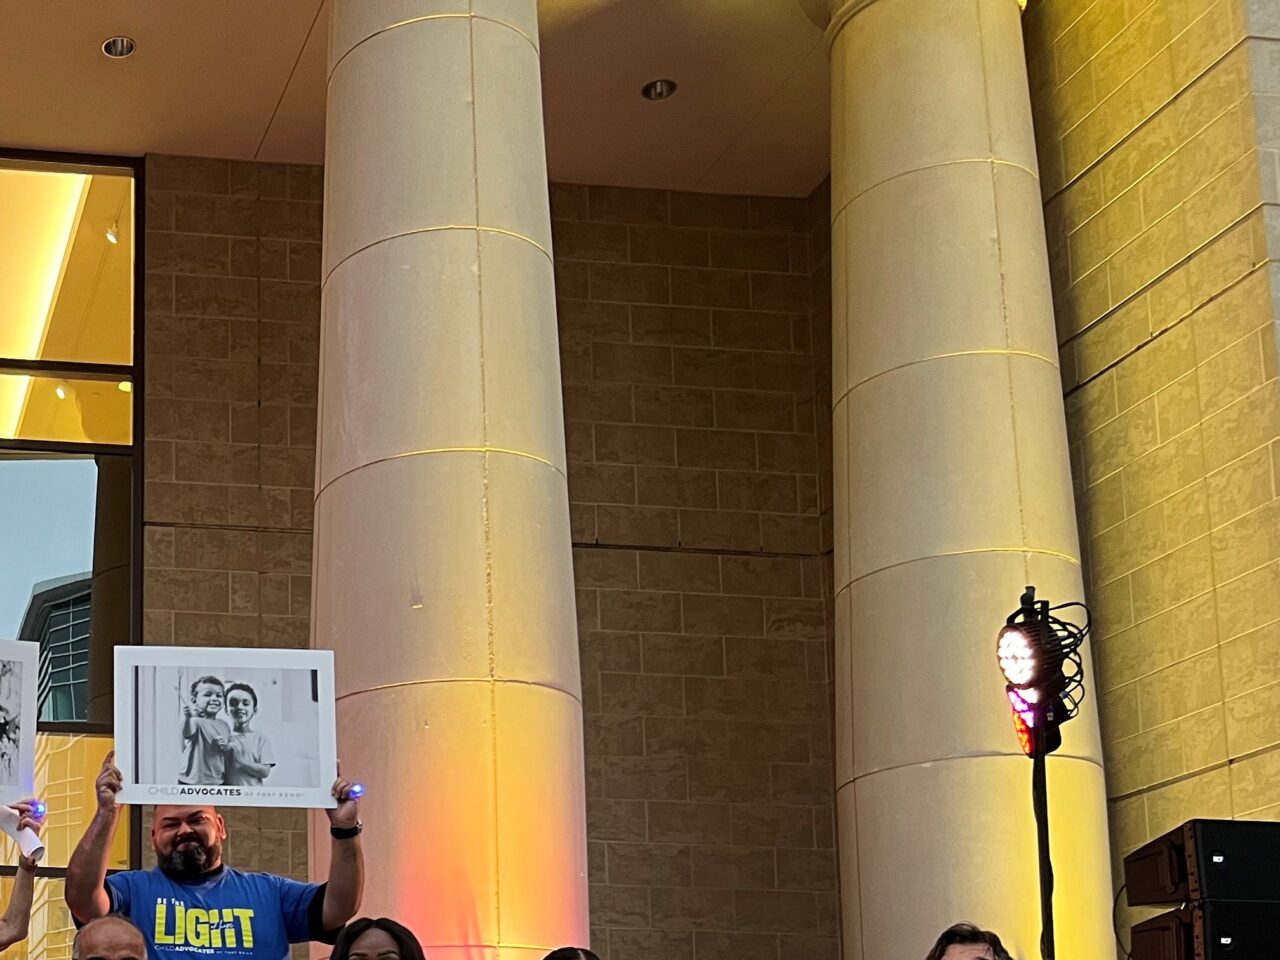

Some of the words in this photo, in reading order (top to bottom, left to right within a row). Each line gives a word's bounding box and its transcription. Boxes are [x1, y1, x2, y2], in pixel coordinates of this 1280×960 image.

[180, 787, 241, 797] ADVOCATES
[154, 903, 255, 949] LIGHT
[175, 946, 215, 954] ADVOCATES
